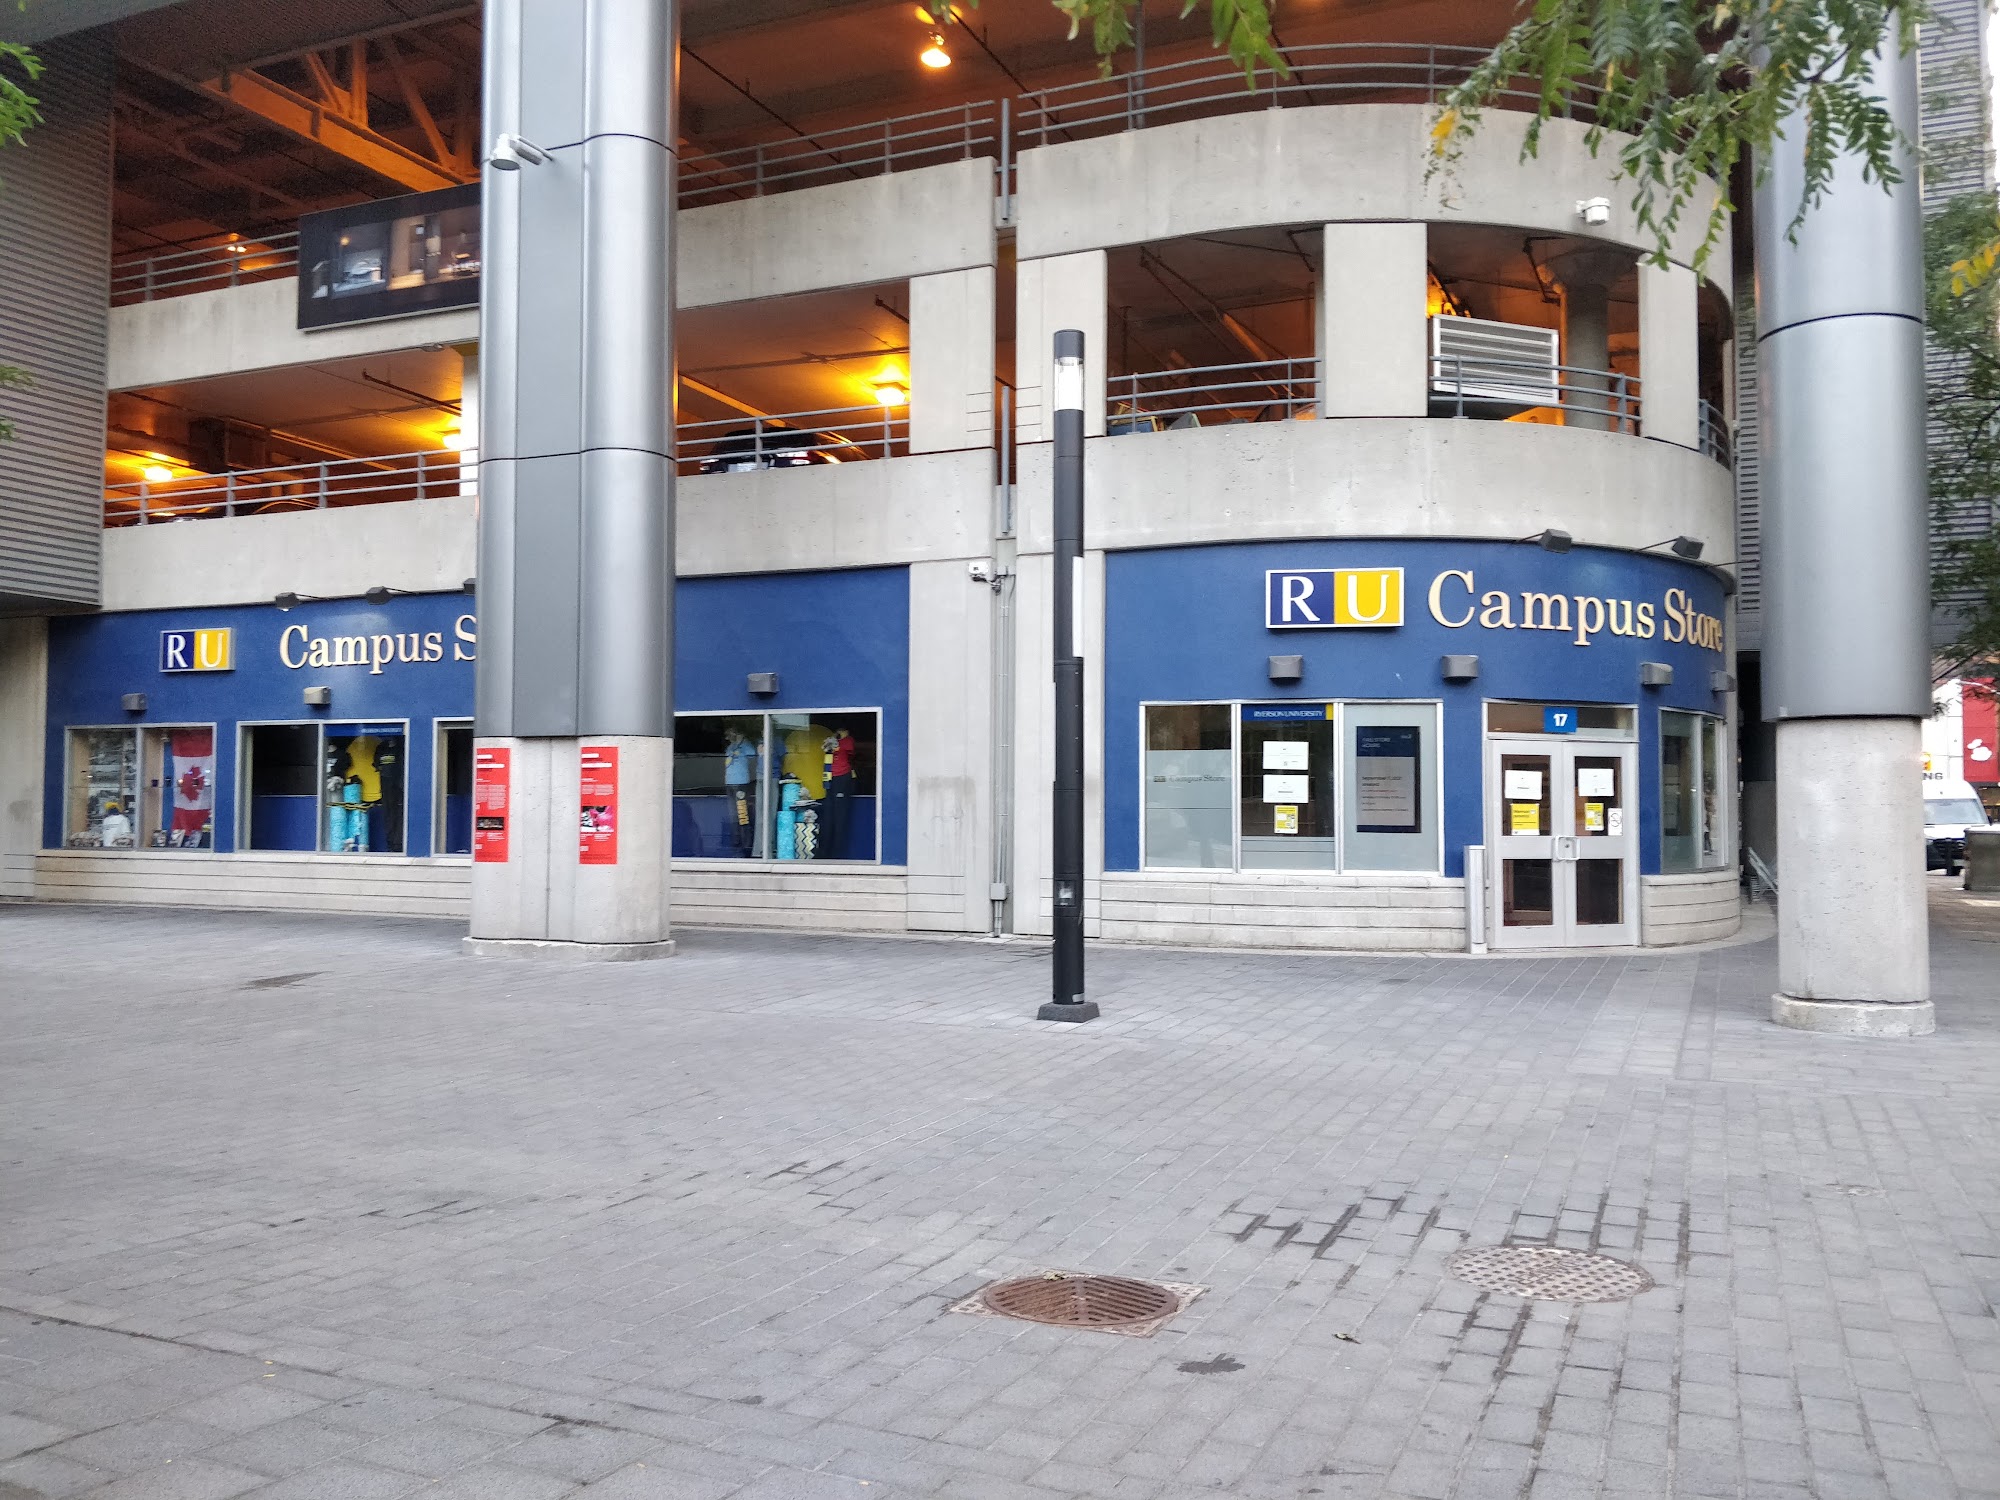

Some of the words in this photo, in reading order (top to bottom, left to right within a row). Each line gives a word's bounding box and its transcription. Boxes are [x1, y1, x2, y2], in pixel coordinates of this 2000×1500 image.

[1428, 569, 1655, 646] Campus
[1663, 588, 1724, 652] Store
[279, 624, 444, 675] Campus
[1285, 710, 1325, 718] UNIVERSITY
[1553, 713, 1568, 727] 17
